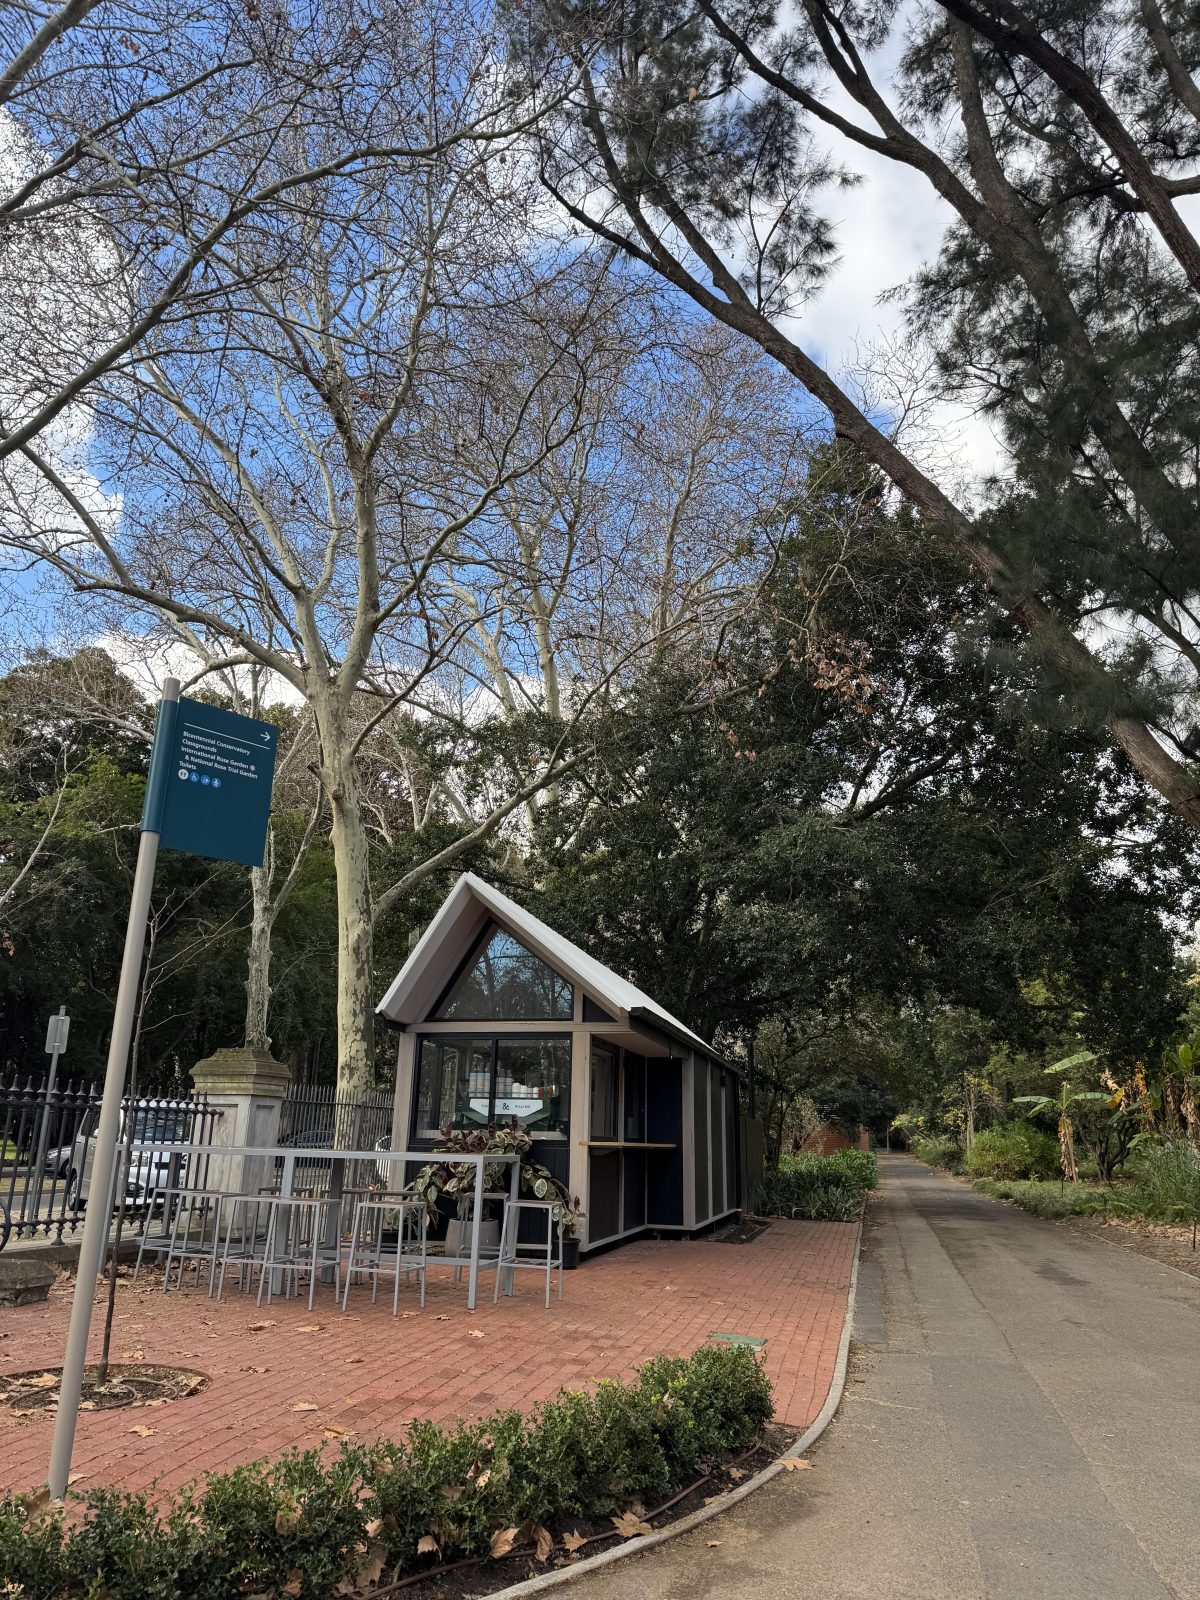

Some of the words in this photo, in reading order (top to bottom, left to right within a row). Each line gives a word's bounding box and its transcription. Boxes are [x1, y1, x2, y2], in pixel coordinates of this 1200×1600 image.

[183, 731, 216, 745] Bicentennial
[216, 741, 251, 755] Conservatory
[179, 761, 197, 770] Toilets
[181, 746, 216, 760] International
[216, 756, 229, 764] Rose
[229, 759, 249, 769] Garden
[190, 756, 213, 767] National
[213, 762, 227, 771] Rose
[227, 766, 239, 774] Trial
[239, 770, 258, 779] Garden
